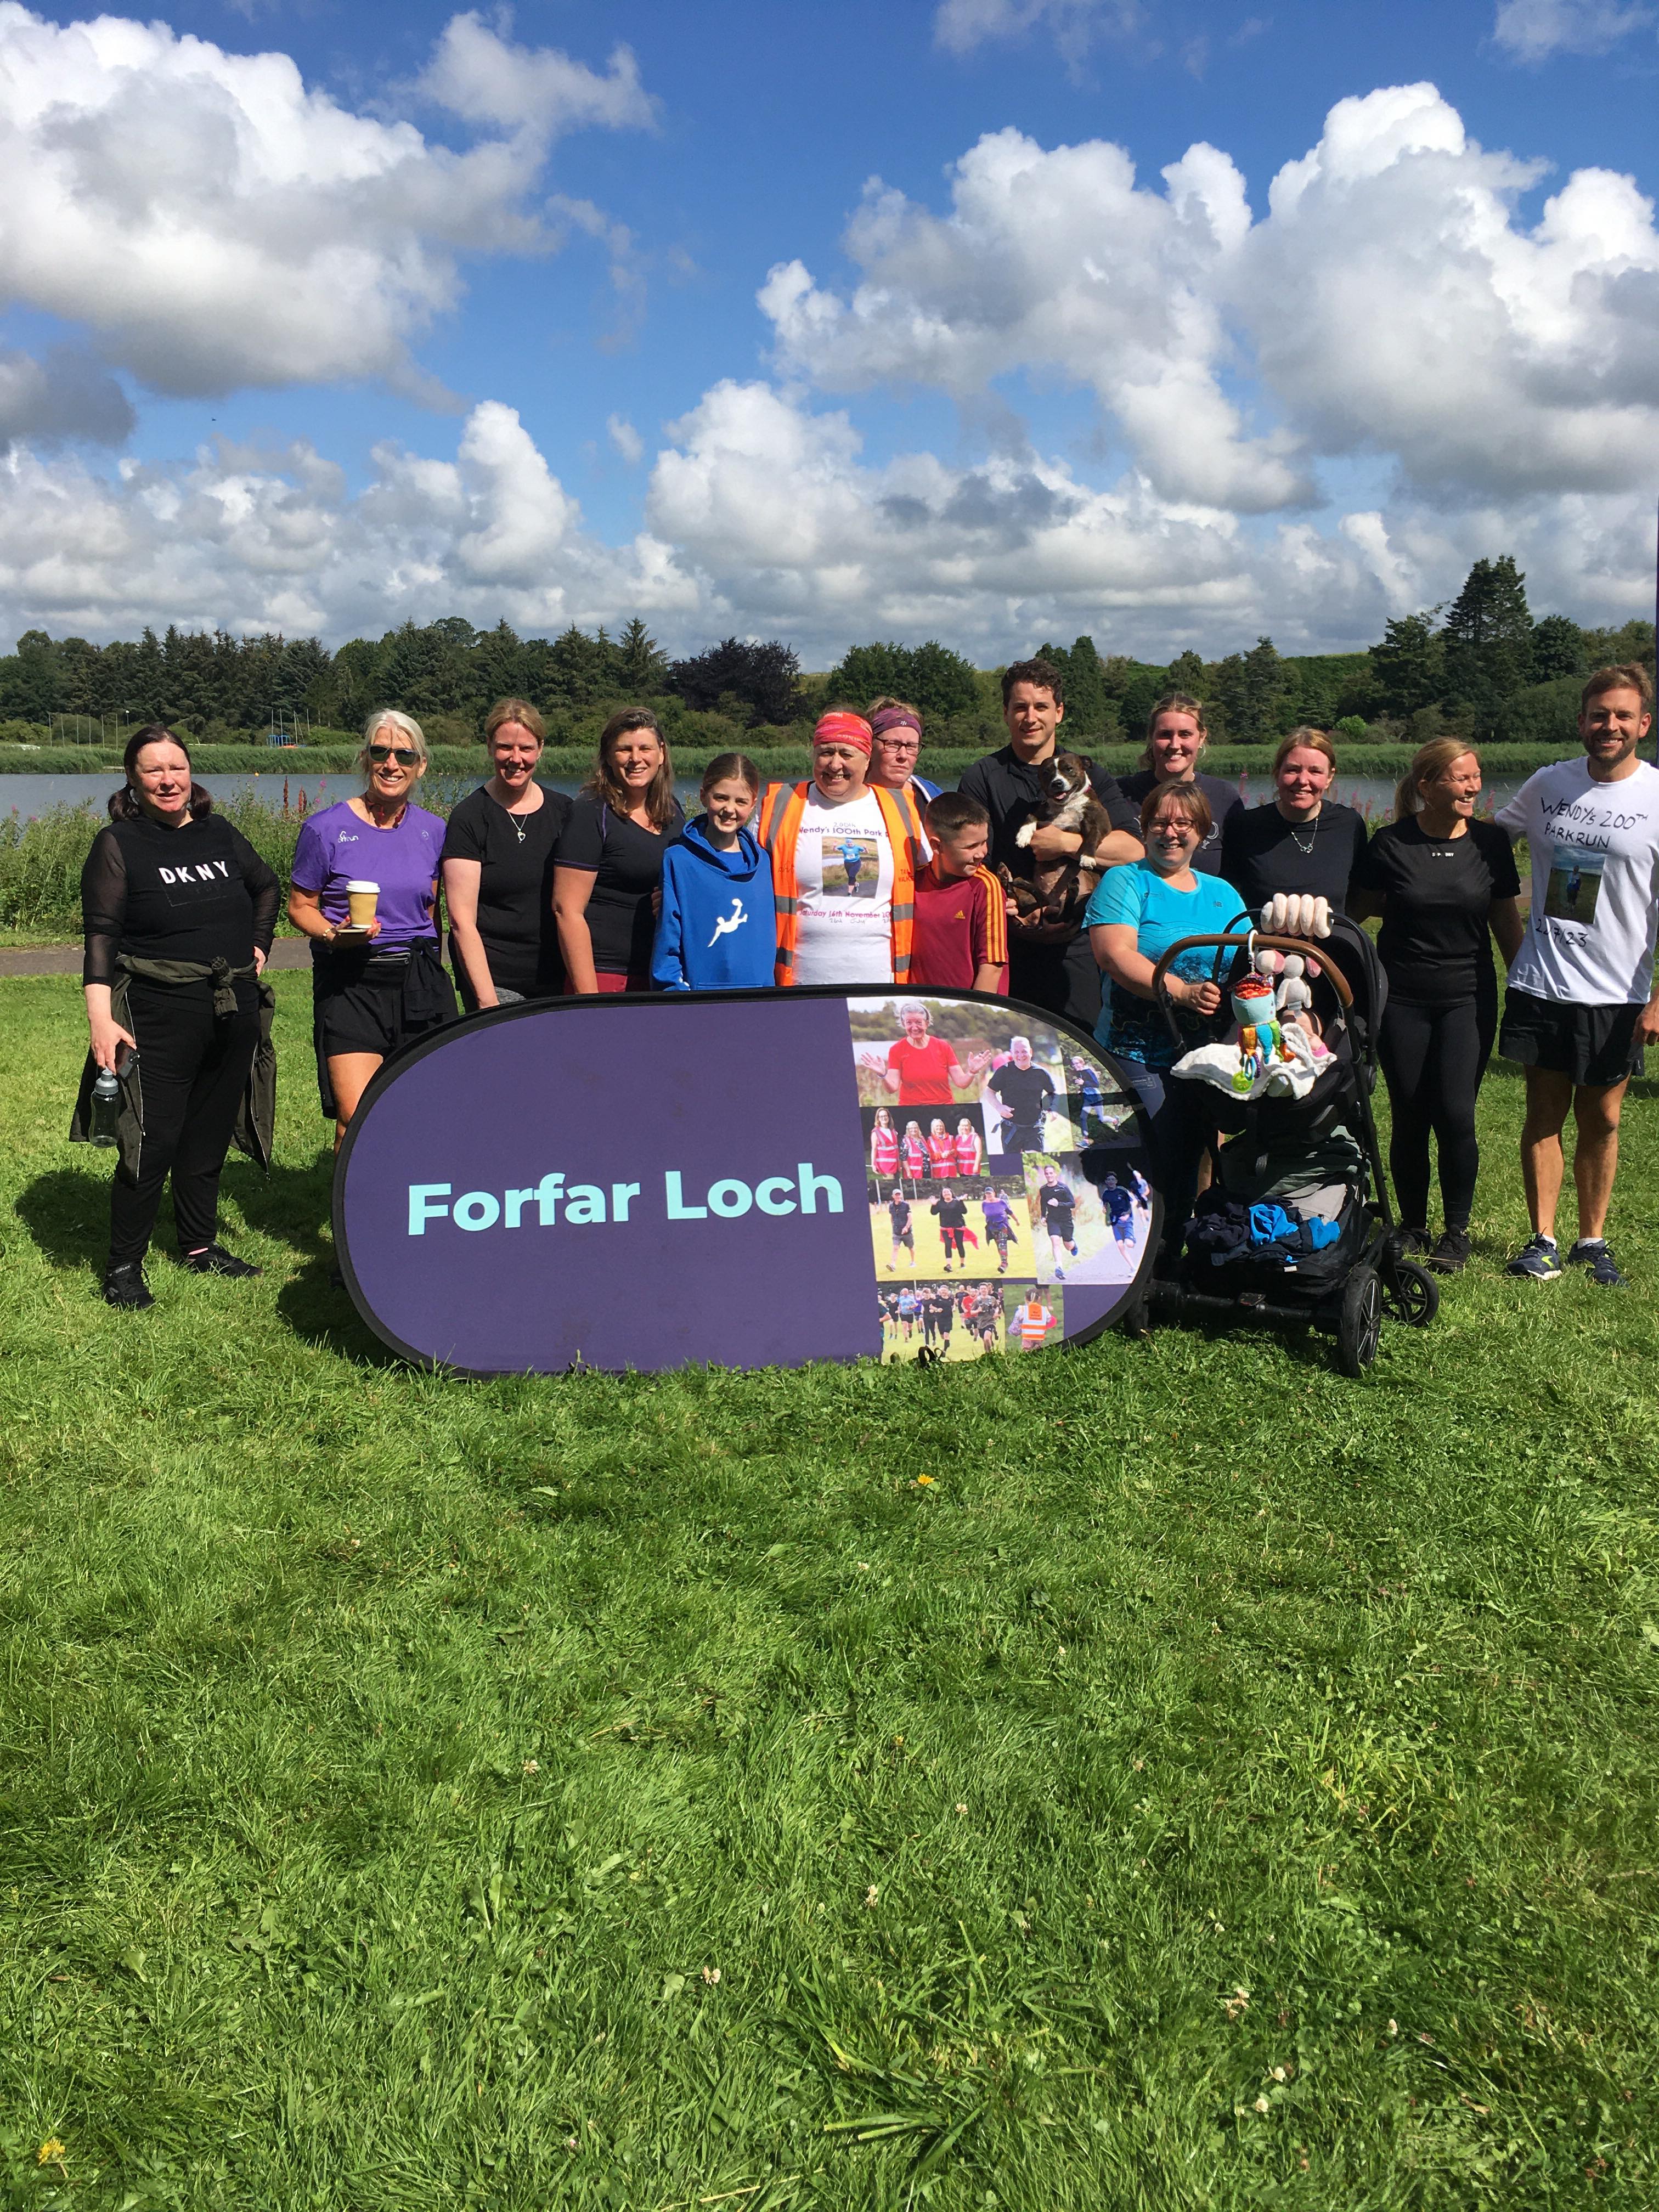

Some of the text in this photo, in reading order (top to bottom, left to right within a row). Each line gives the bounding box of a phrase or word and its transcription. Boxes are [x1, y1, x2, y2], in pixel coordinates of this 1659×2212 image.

[1544, 822, 1611, 849] PARKRUN
[158, 861, 229, 884] DKNY
[408, 1163, 844, 1235] Forfar Loch
